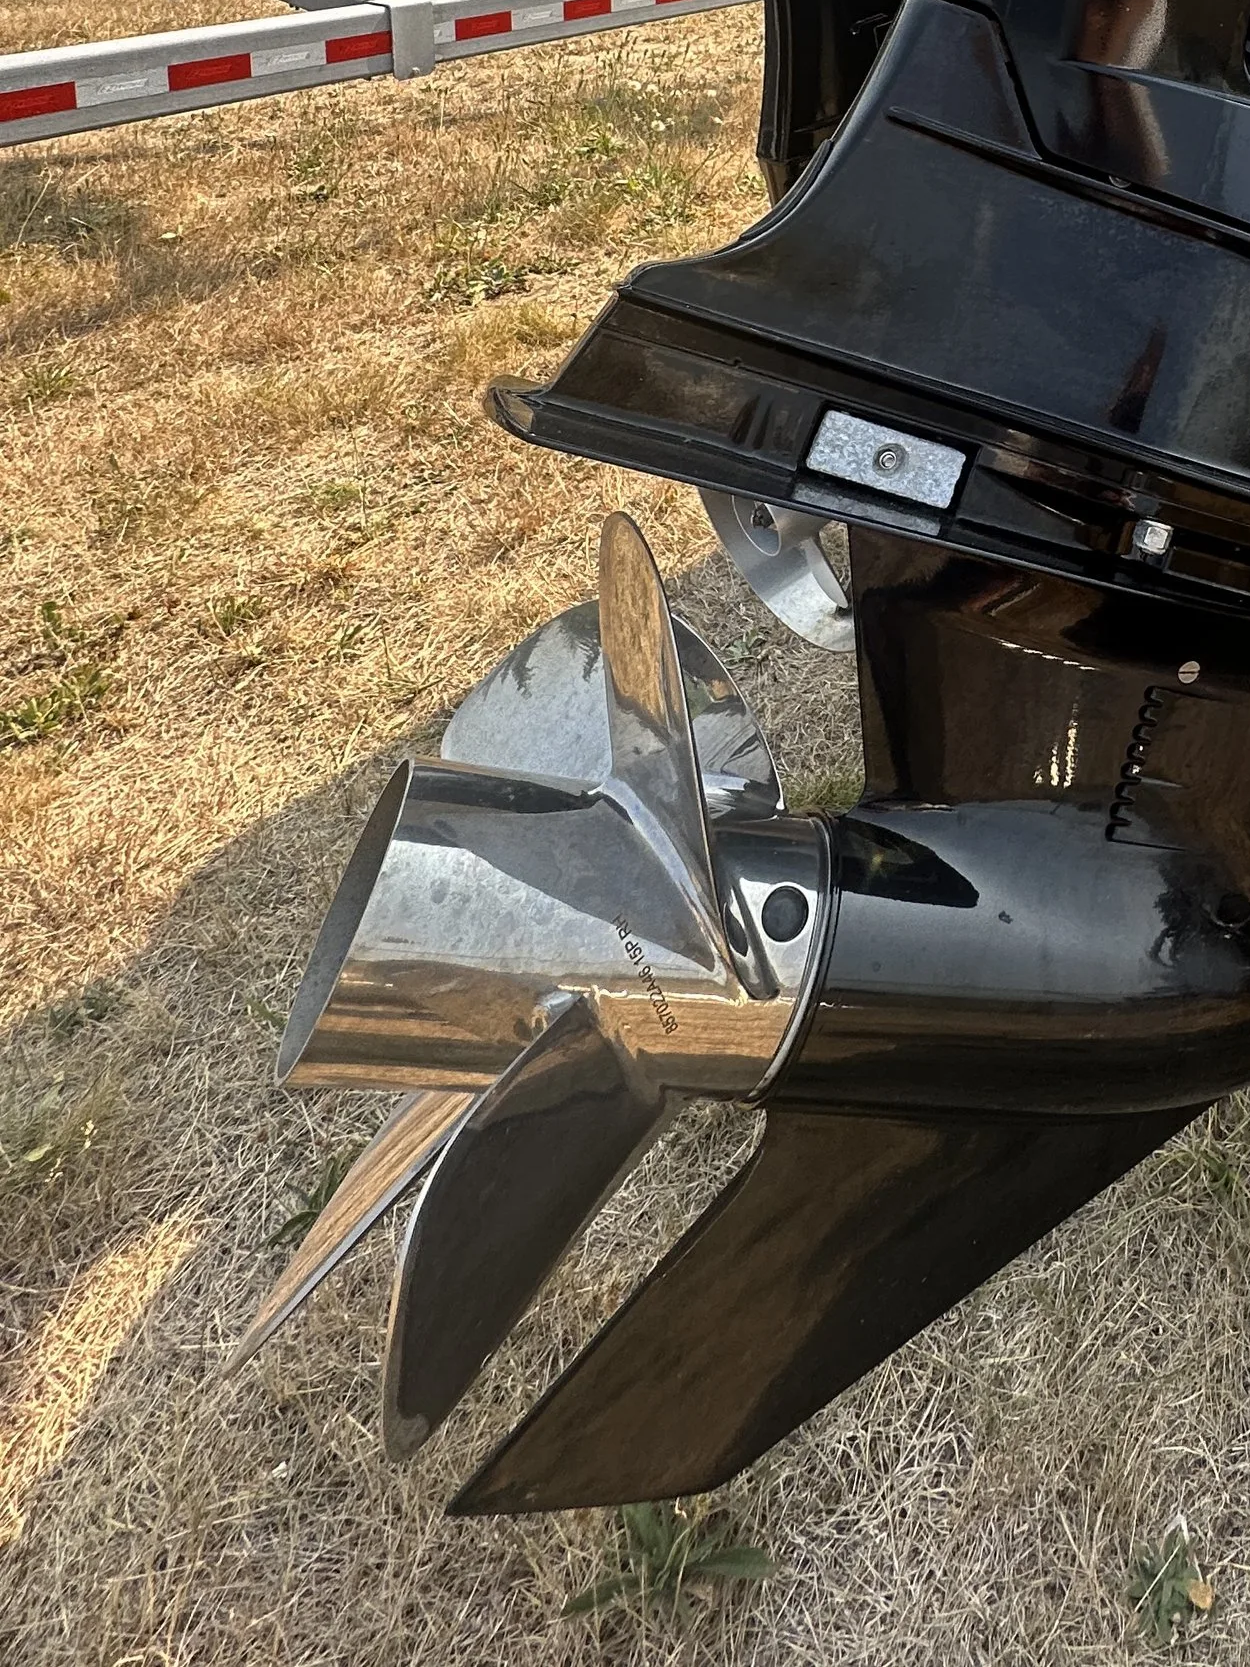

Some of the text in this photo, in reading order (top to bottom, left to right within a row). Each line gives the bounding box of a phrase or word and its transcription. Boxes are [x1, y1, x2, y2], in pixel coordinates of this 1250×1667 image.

[610, 913, 678, 1035] 857022A46 15P RH
